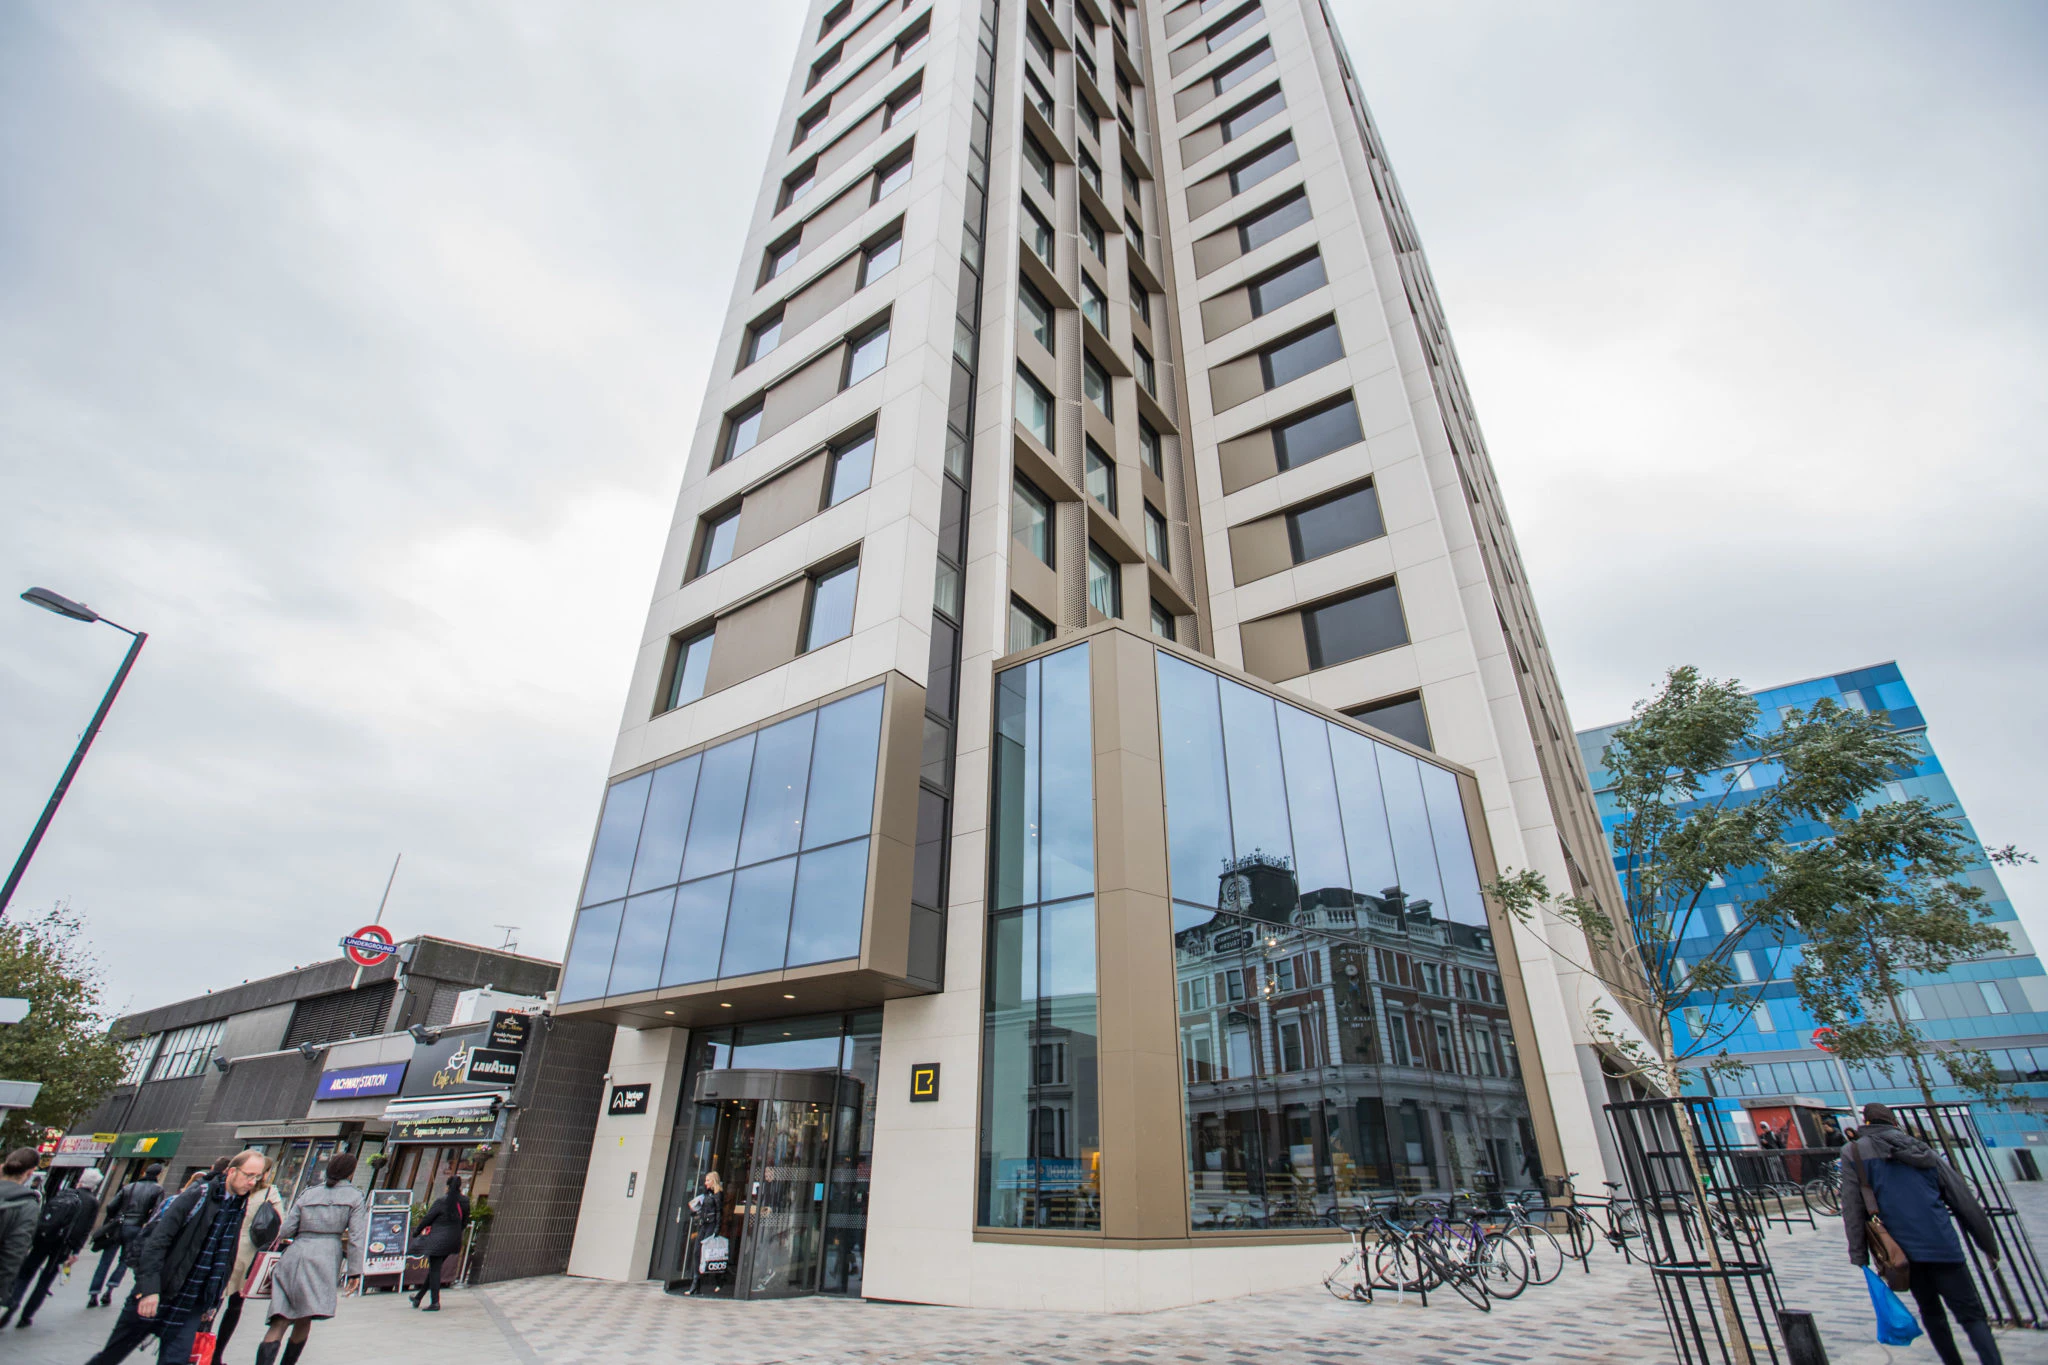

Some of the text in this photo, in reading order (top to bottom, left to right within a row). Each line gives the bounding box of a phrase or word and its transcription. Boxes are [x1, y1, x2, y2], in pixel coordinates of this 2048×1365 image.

[346, 938, 395, 952] UNDERGROUND
[472, 1060, 516, 1075] LAVAZZA
[330, 1073, 388, 1091] ARCHWAY STATION
